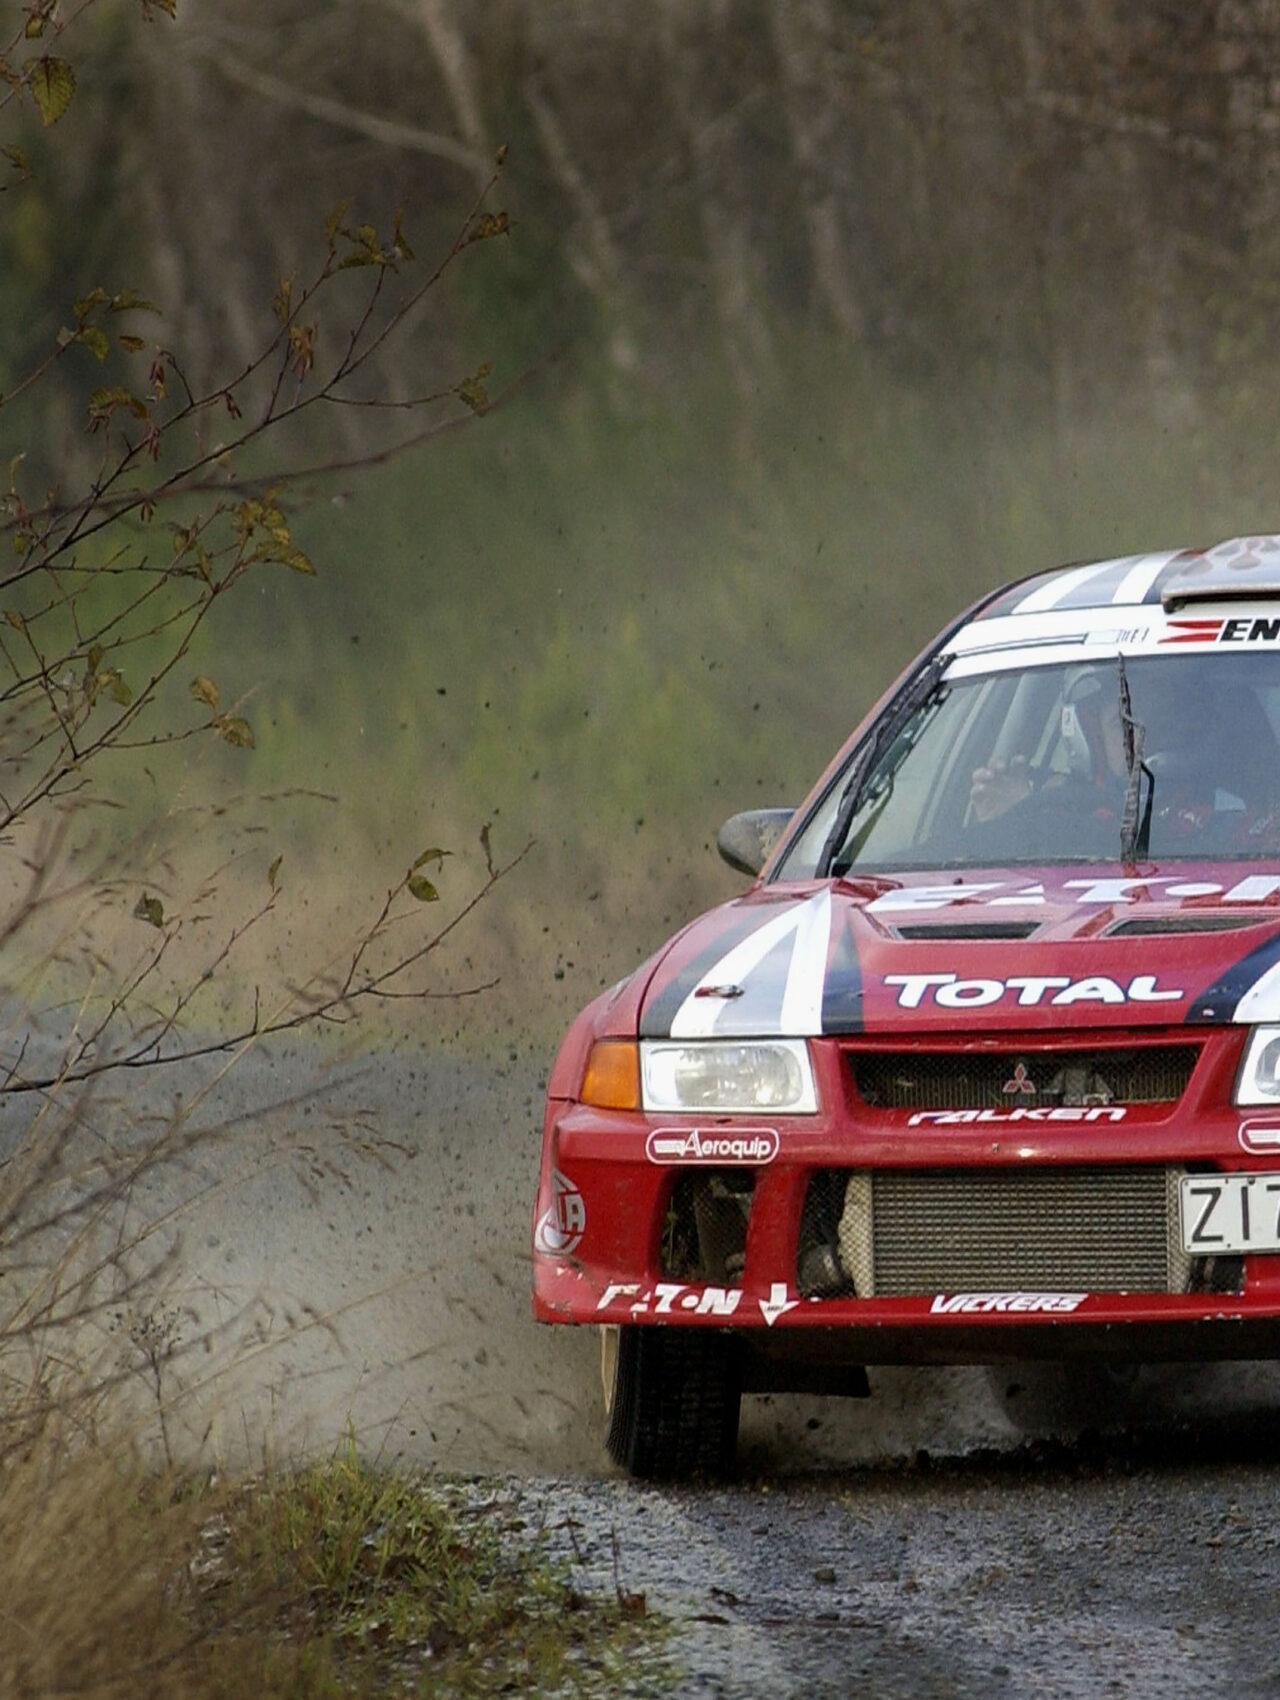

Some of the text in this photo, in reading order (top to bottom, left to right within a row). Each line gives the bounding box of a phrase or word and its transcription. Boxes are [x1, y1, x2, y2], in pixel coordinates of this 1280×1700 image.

[883, 973, 1184, 1008] TOTAL
[907, 1107, 1127, 1127] FALKEN
[682, 1129, 772, 1159] Aeroquip
[929, 1291, 1090, 1314] VICKERS
